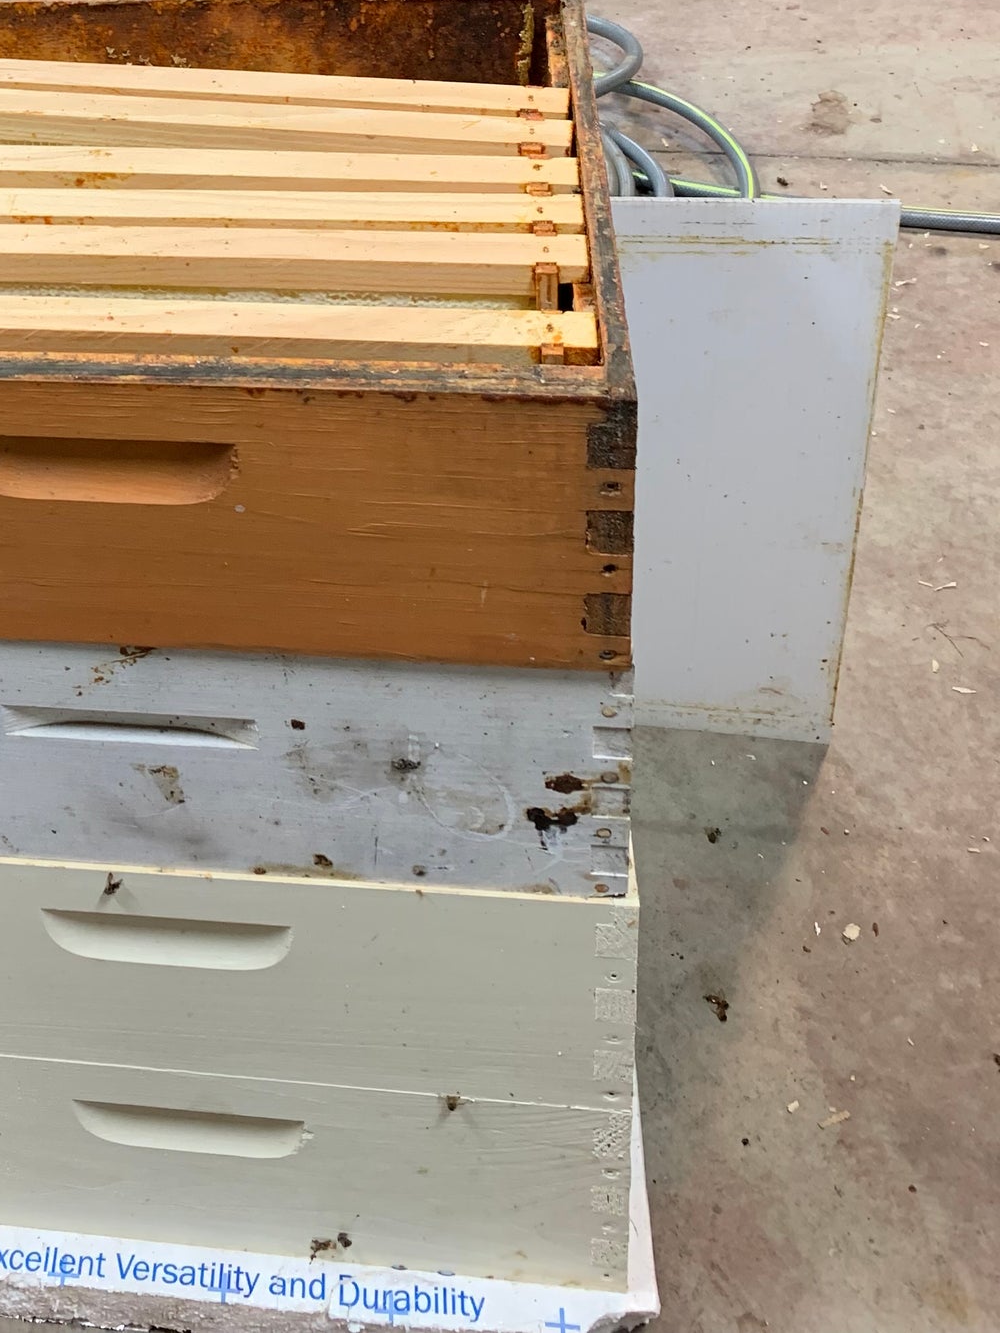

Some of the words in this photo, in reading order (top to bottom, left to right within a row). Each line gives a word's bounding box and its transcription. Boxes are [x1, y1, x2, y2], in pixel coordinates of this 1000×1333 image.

[116, 1252, 261, 1297] Versatility
[268, 1273, 327, 1301] and
[338, 1274, 486, 1323] Durability
